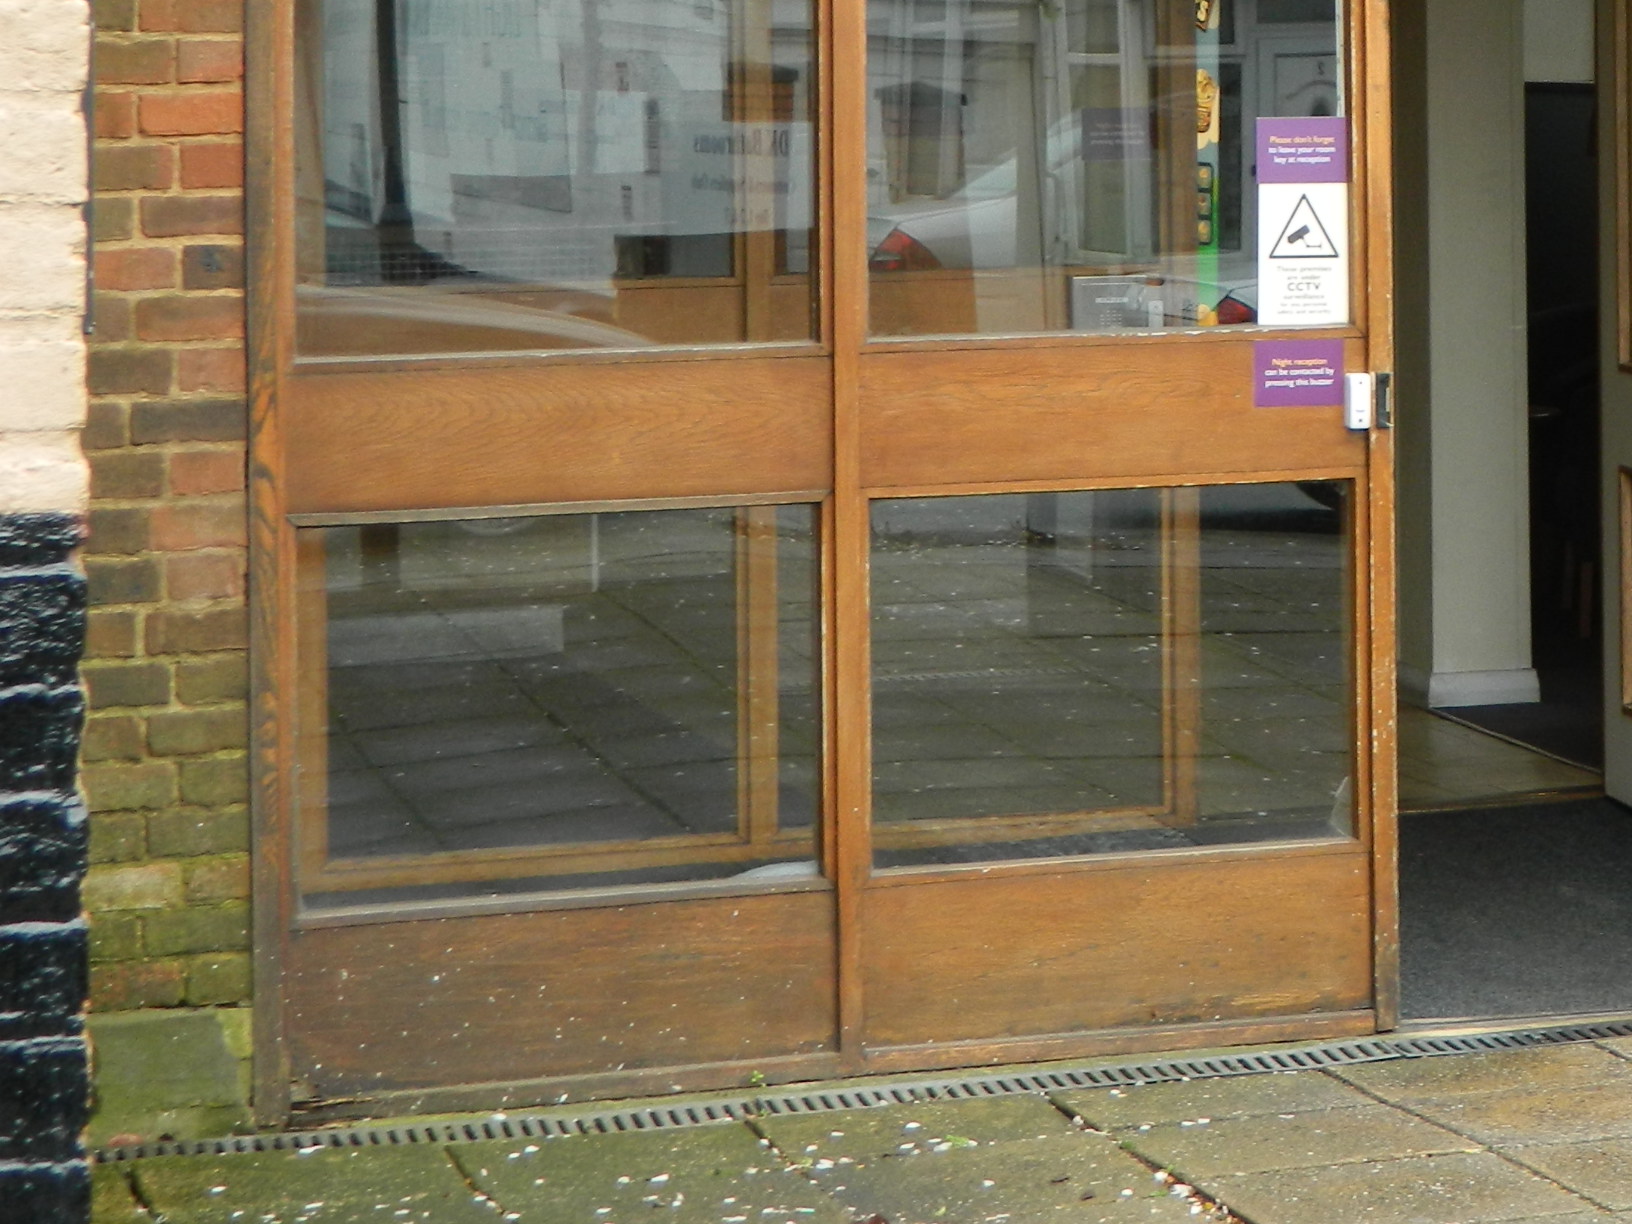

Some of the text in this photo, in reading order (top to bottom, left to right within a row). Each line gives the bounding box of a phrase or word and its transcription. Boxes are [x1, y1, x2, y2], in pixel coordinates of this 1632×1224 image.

[1269, 136, 1292, 144] Please
[1297, 147, 1314, 155] your
[1296, 156, 1331, 164] reception
[1287, 282, 1321, 291] CCTV
[1272, 358, 1328, 367] Night reception
